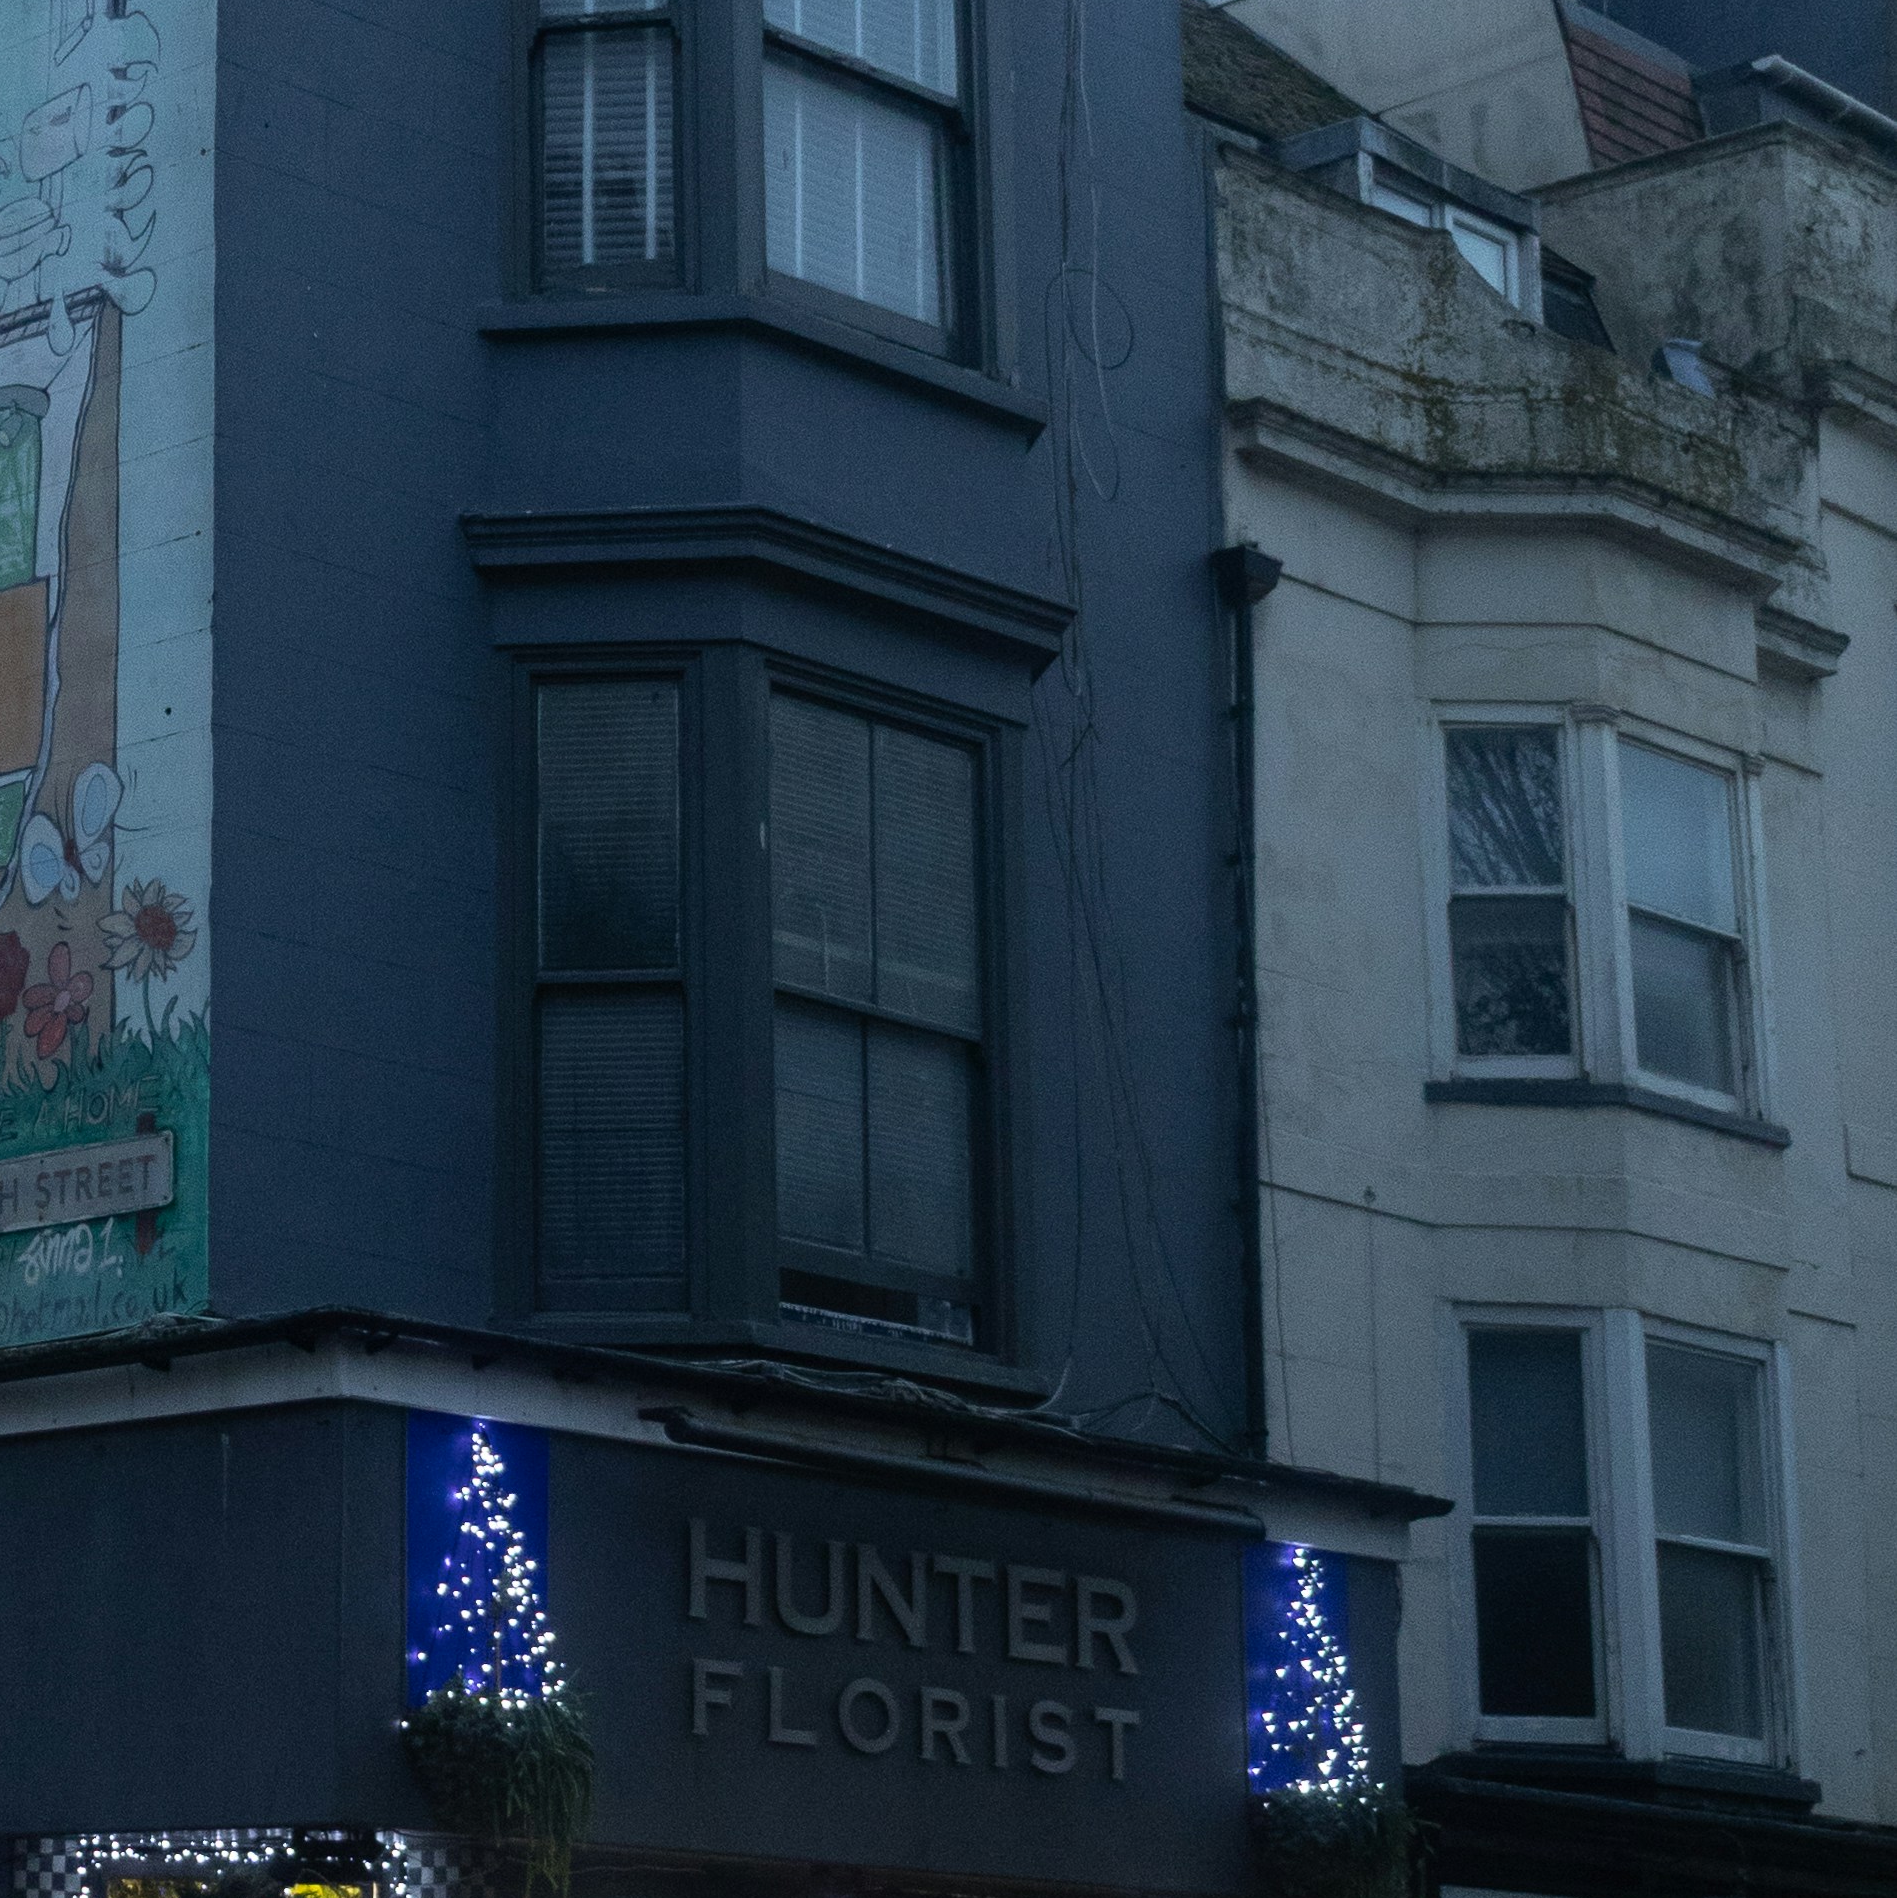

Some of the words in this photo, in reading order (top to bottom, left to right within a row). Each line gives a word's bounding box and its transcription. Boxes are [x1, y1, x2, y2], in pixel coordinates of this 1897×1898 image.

[35, 1155, 157, 1208] STREET
[688, 1516, 1142, 1676] HUNTER
[692, 1658, 1142, 1782] FLORIST
